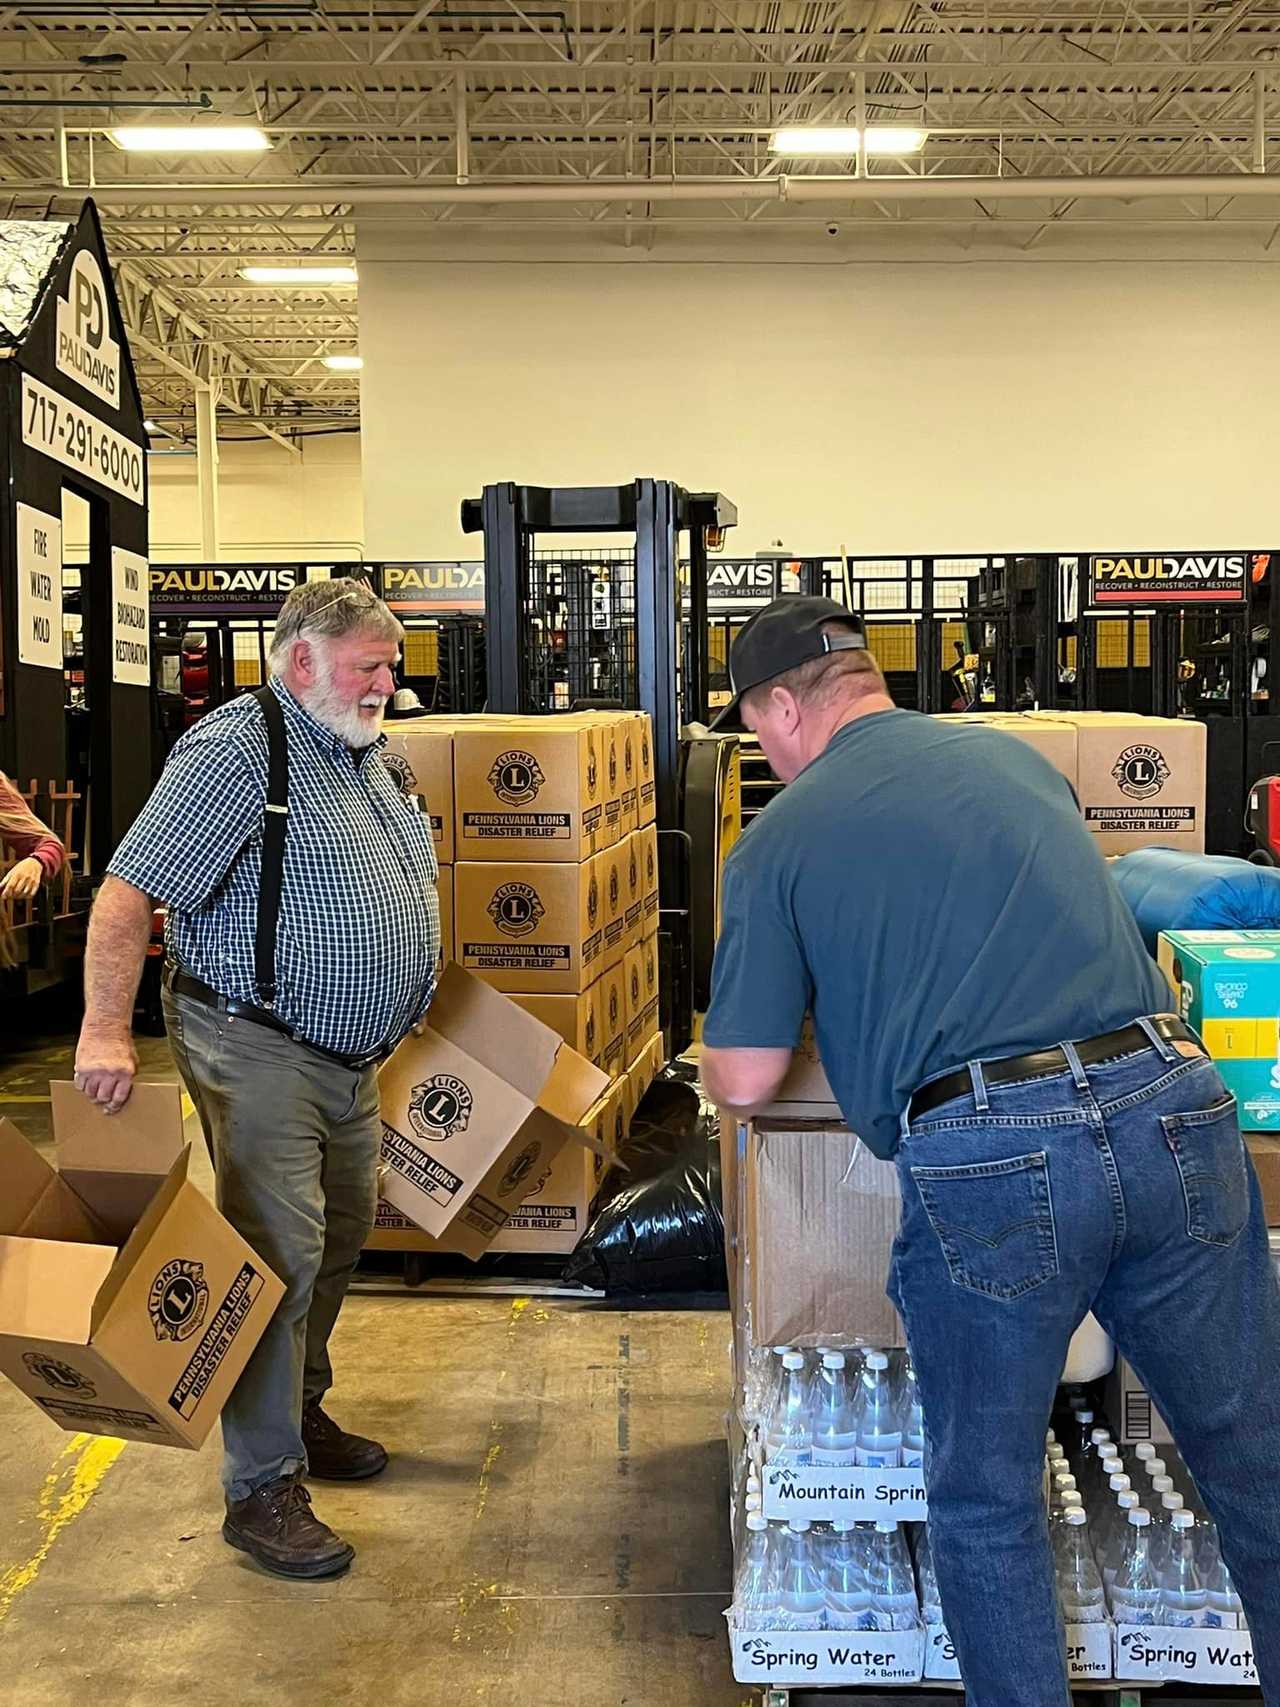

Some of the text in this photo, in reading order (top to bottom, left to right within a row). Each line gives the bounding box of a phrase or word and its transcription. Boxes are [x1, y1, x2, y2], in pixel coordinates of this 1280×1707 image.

[27, 390, 140, 493] 717-291-6000
[33, 528, 48, 558] FIRE
[30, 571, 52, 602] WATER
[124, 566, 139, 591] WIND
[1095, 581, 1242, 590] RECOVER RECONSTRUCT RESTORE
[735, 588, 771, 596] RESTORE
[117, 602, 146, 630] BIOHAZARD
[32, 615, 50, 644] MOLD
[115, 639, 148, 666] RESTORATION
[500, 753, 532, 765] LIONS
[1125, 747, 1158, 759] LIONS
[510, 768, 525, 787] L
[1134, 761, 1149, 780] L
[468, 814, 566, 826] PENNSYLVANIA LIONS
[1090, 809, 1190, 819] PENNSYLVANIA LIONS
[478, 827, 556, 837] DISASTER RELIEF
[1100, 820, 1180, 830] DISASTER RELIEF
[500, 885, 532, 897] LIONS
[510, 900, 525, 919] L
[468, 945, 565, 956] PENNSYLVANIA LIONS
[477, 958, 556, 968] DISASTER RELIEF
[438, 1077, 470, 1104] LIONS
[428, 1094, 449, 1122] L
[404, 1165, 439, 1193] RELIEF
[426, 1162, 457, 1189] LIONS
[544, 1207, 572, 1218] LIONS
[531, 1219, 562, 1229] RELIEF
[150, 1263, 179, 1307] LIONS
[166, 1289, 193, 1315] L
[174, 1308, 230, 1402] PENNSYLVANIA
[226, 1270, 251, 1309] LIONS
[190, 1336, 229, 1399] DISASTER
[226, 1291, 252, 1337] RELIEF
[778, 1483, 926, 1505] Mountain Sprin
[751, 1648, 896, 1670] Spring Water
[1129, 1644, 1253, 1669] Spring Wat
[864, 1668, 916, 1678] 24 Bottles
[1071, 1662, 1106, 1672] Bottles
[1243, 1670, 1255, 1678] 24
